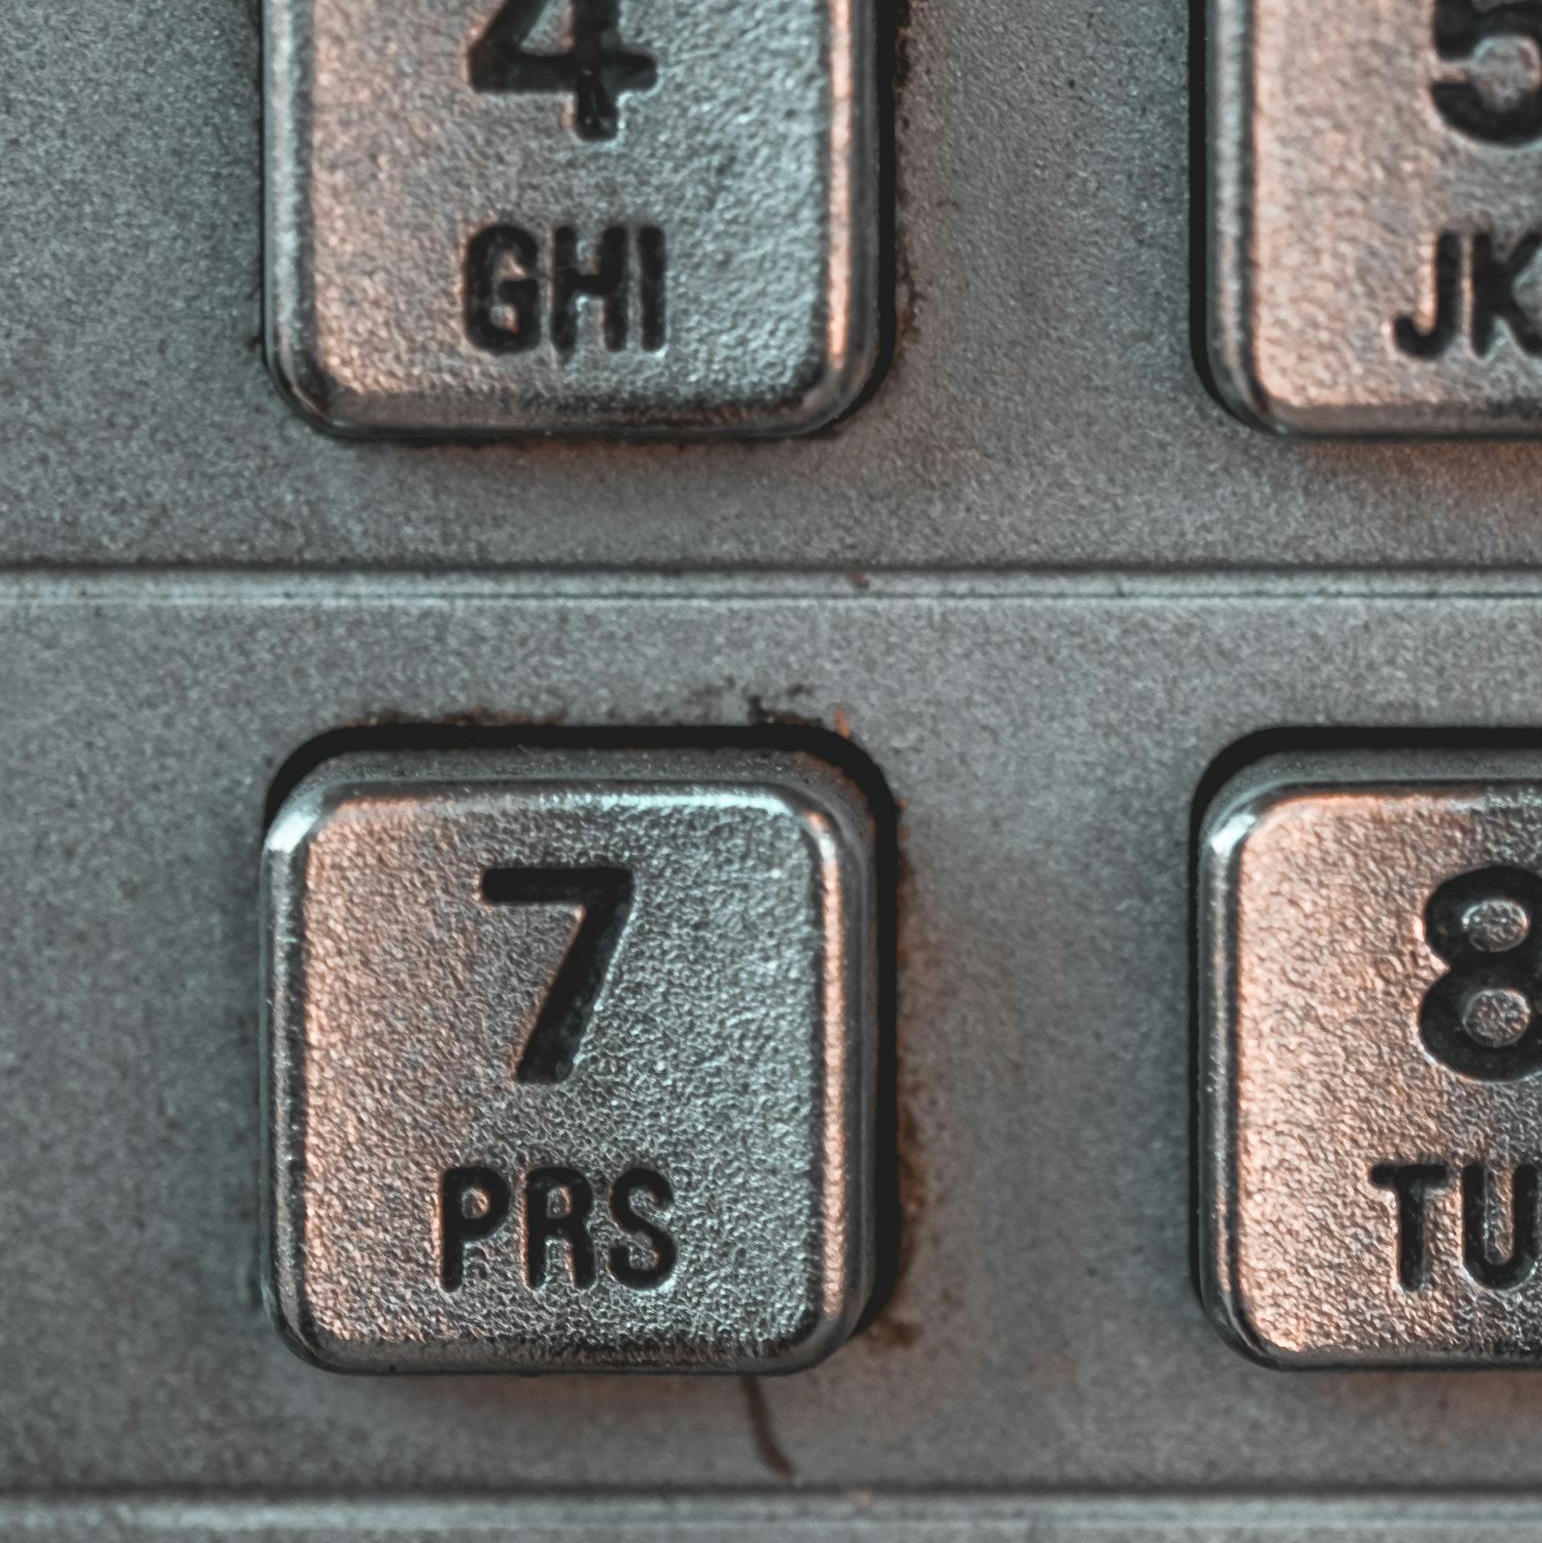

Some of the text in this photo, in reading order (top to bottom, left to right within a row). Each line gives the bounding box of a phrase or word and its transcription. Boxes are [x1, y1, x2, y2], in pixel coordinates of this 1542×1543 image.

[464, 222, 668, 356] GHI
[480, 865, 636, 1083] 7
[441, 1165, 676, 1294] PRS
